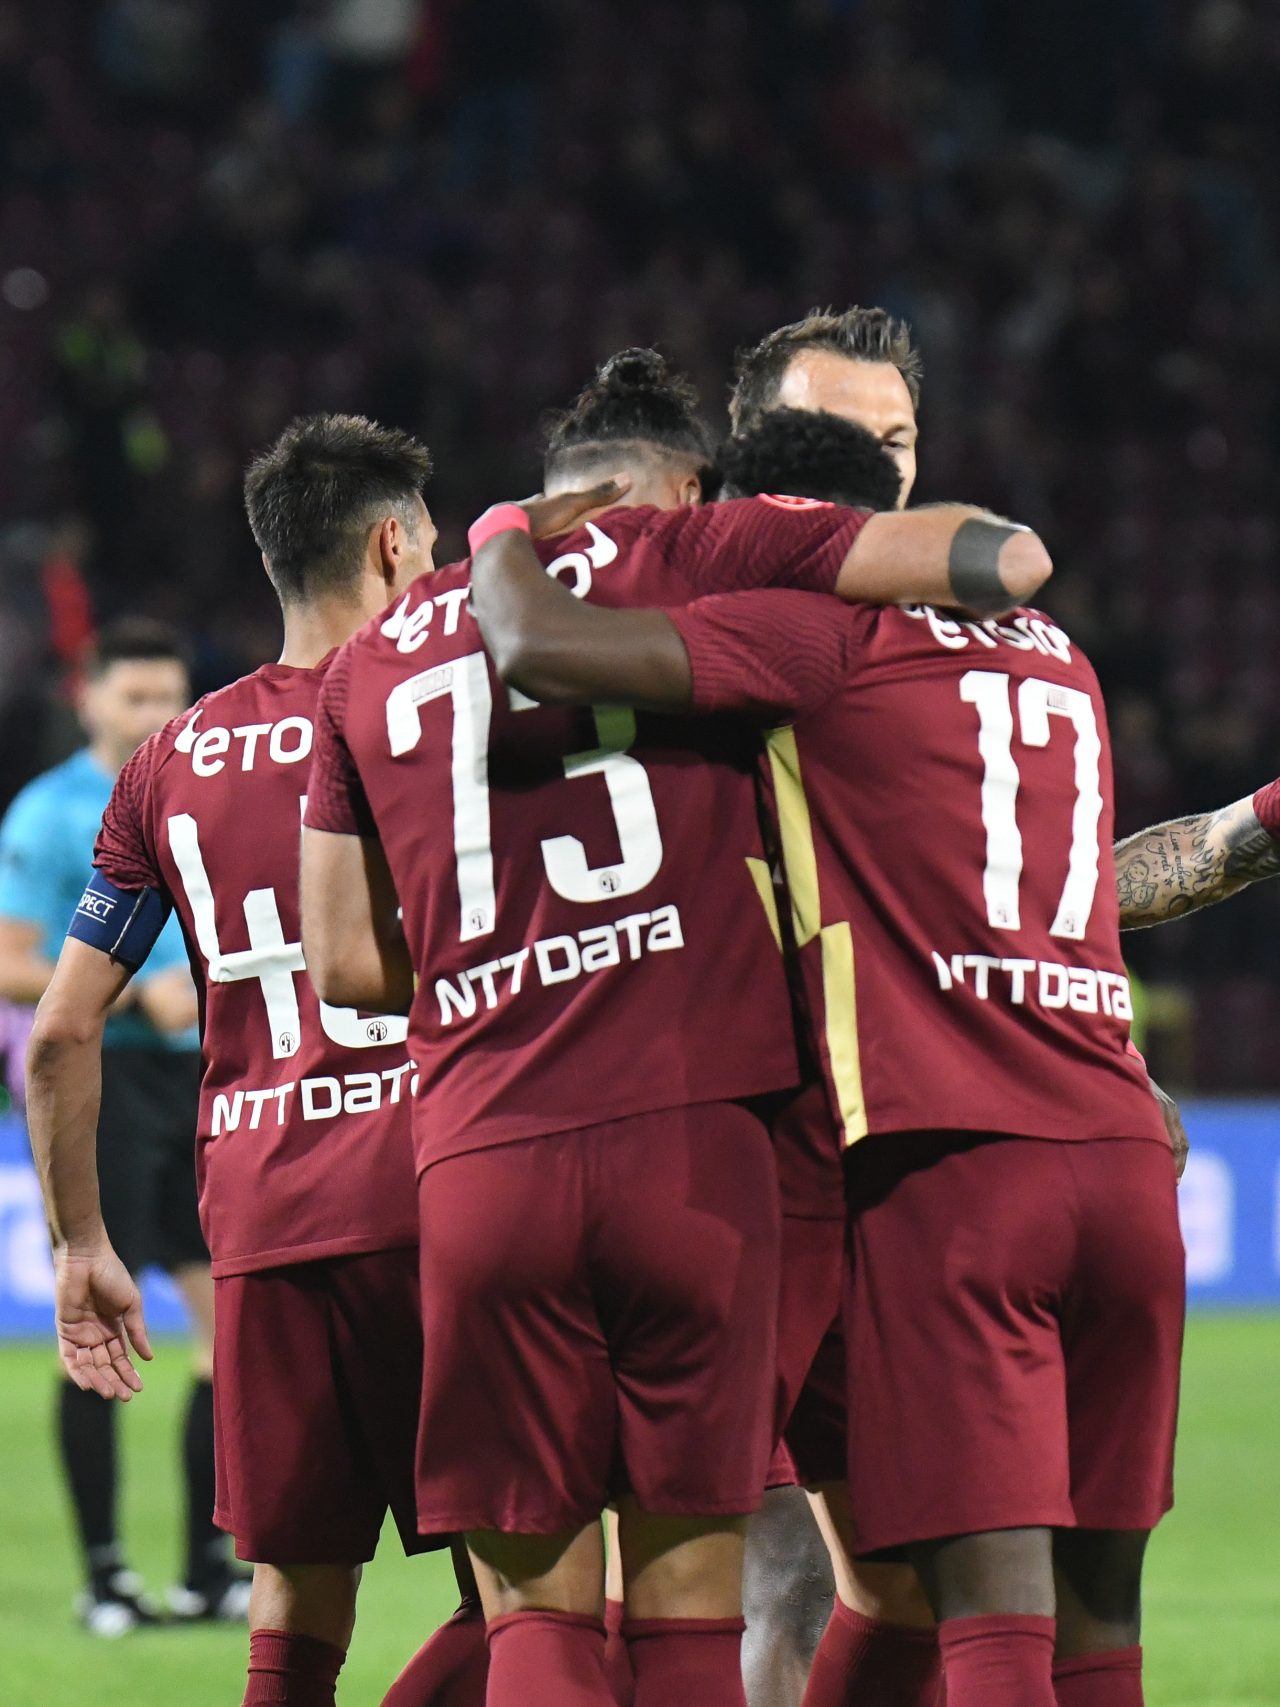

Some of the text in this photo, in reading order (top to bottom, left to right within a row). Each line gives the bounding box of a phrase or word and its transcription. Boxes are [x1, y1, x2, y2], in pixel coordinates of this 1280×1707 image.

[397, 552, 592, 653] eTo
[193, 715, 313, 777] eTo
[960, 670, 1104, 940] 17
[79, 893, 115, 917] SPECT
[434, 947, 529, 1027] NTT
[211, 1081, 295, 1137] NTT
